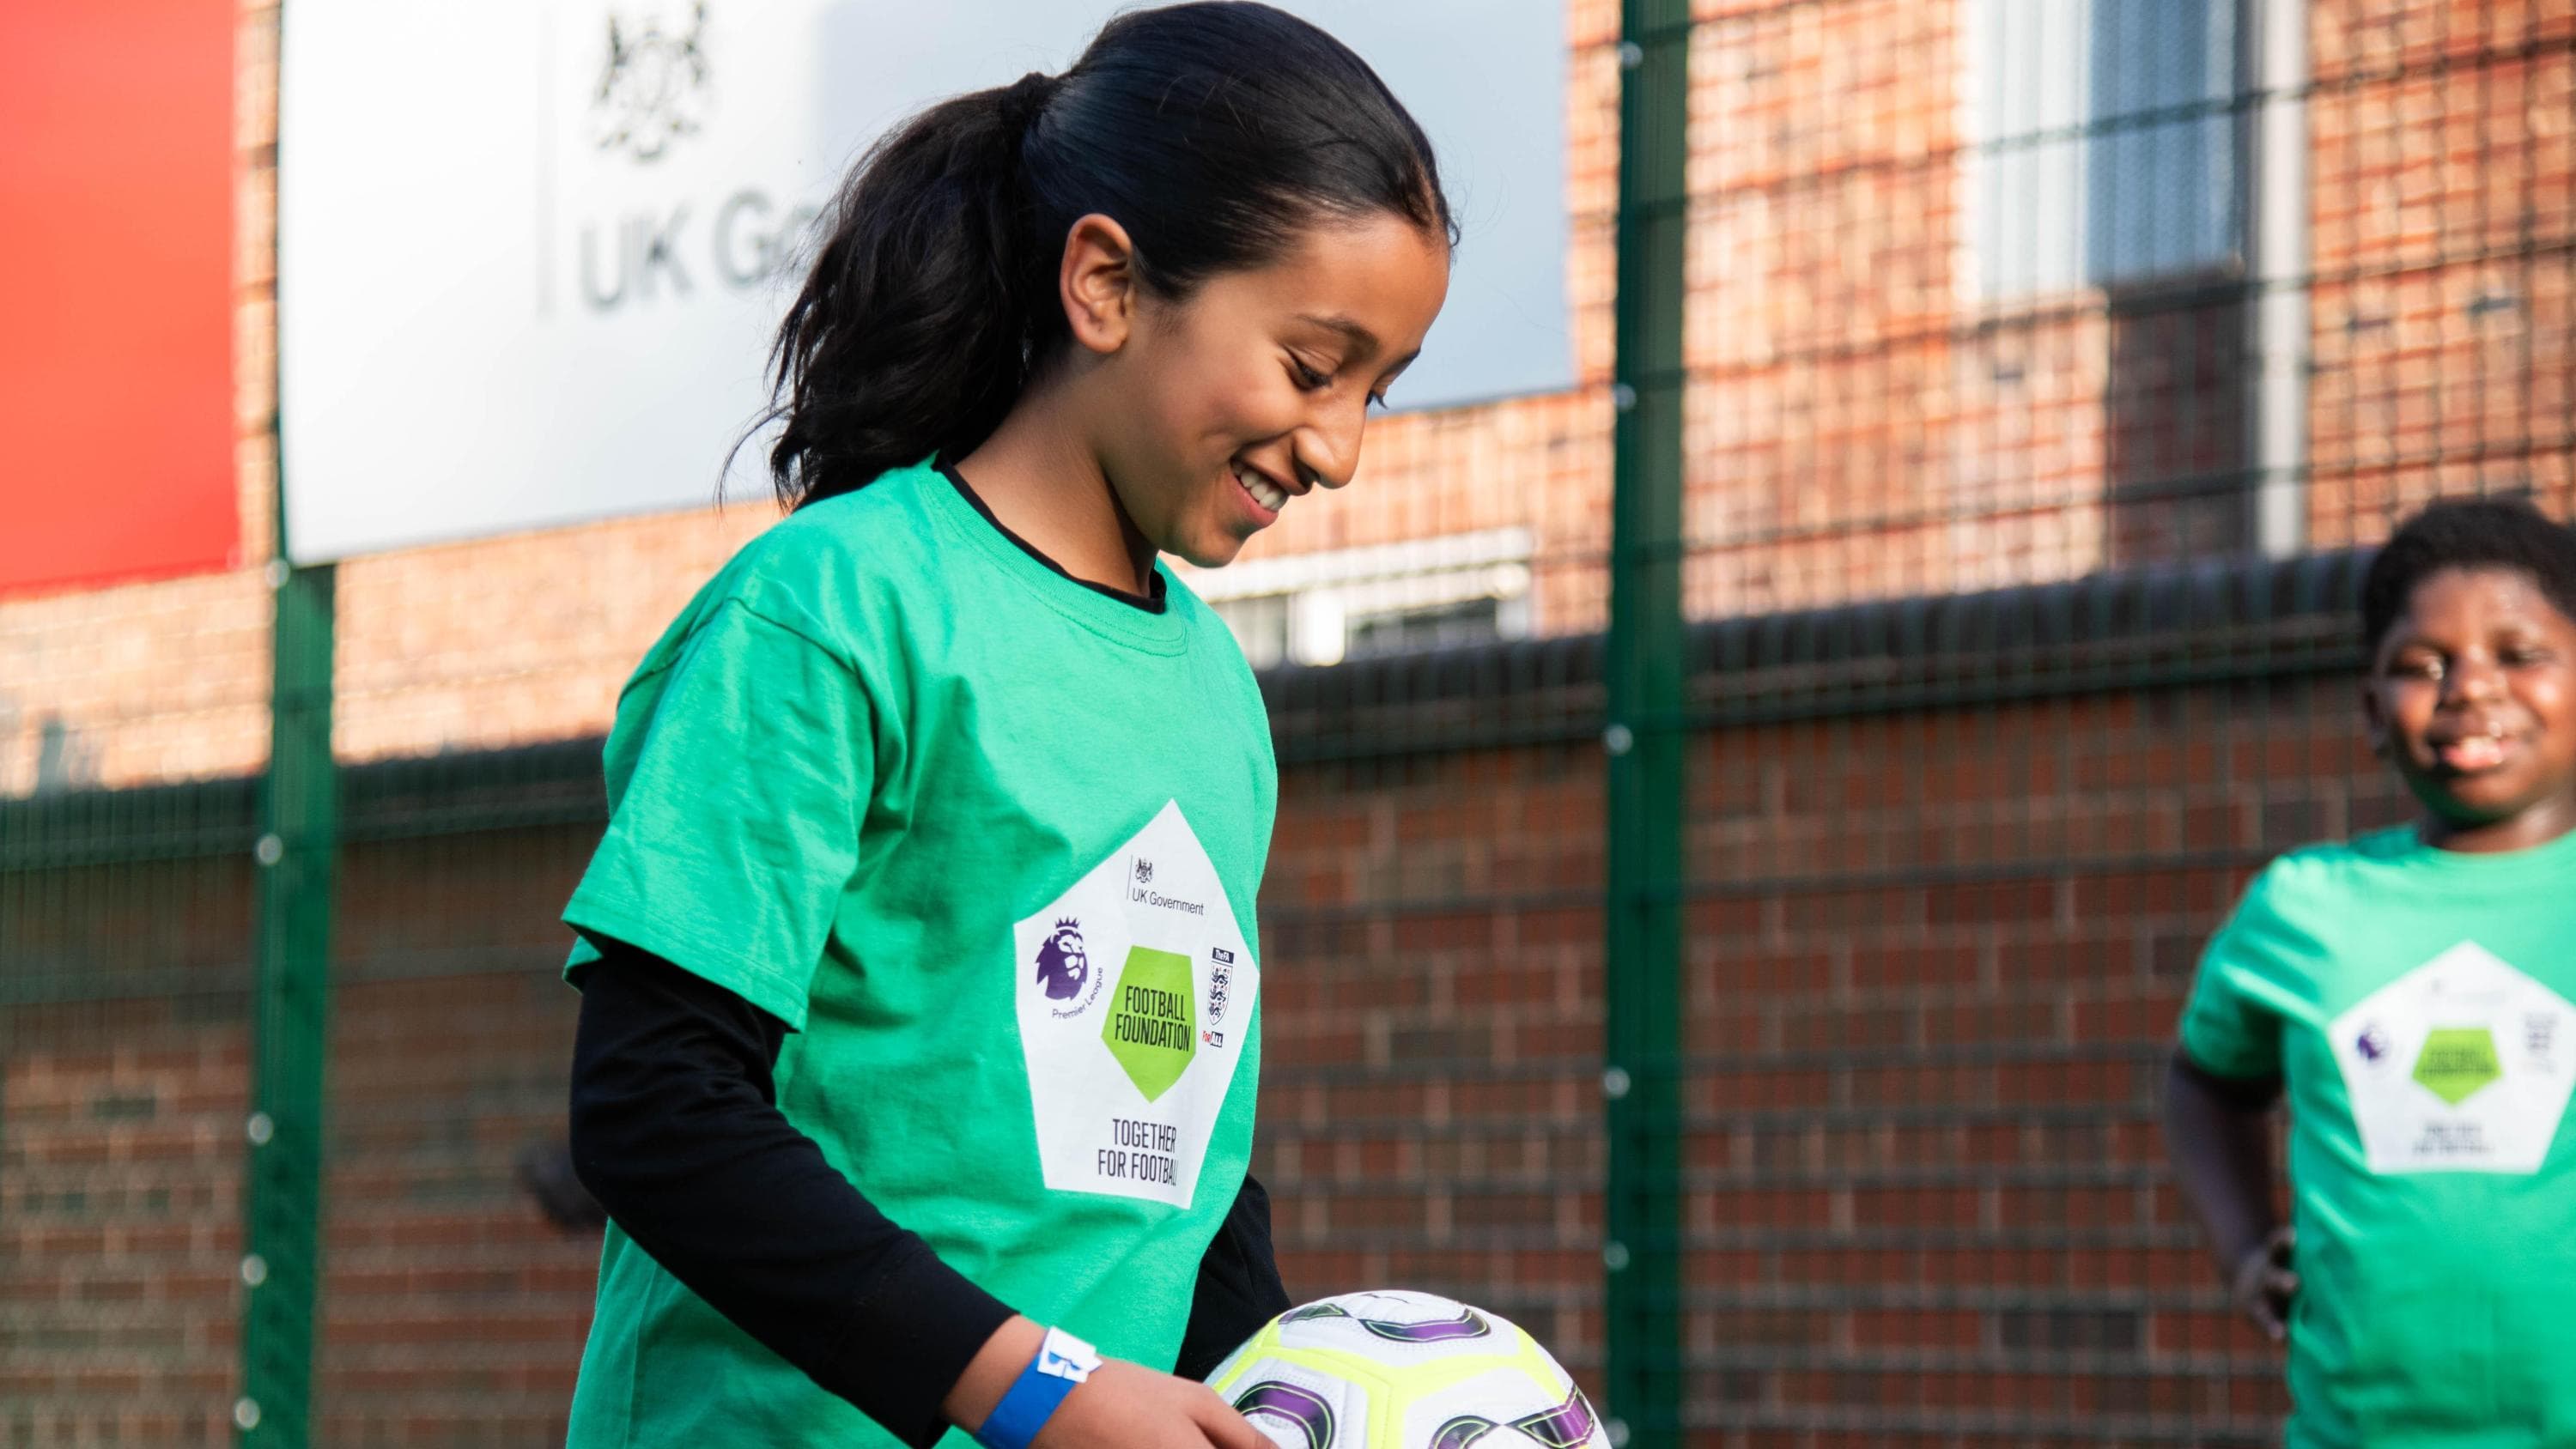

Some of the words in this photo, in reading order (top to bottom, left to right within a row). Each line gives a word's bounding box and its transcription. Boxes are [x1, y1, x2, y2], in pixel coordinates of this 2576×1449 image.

[577, 197, 696, 312] UK
[1133, 887, 1148, 904] UK
[1150, 891, 1204, 916] Government
[1052, 1003, 1086, 1019] Premier
[1084, 967, 1103, 1006] League
[1125, 985, 1186, 1022] FOOTBALL
[1115, 1013, 1191, 1052] FOUNDATION
[1112, 1119, 1176, 1154] TOGETHER
[1098, 1149, 1127, 1179] FOR
